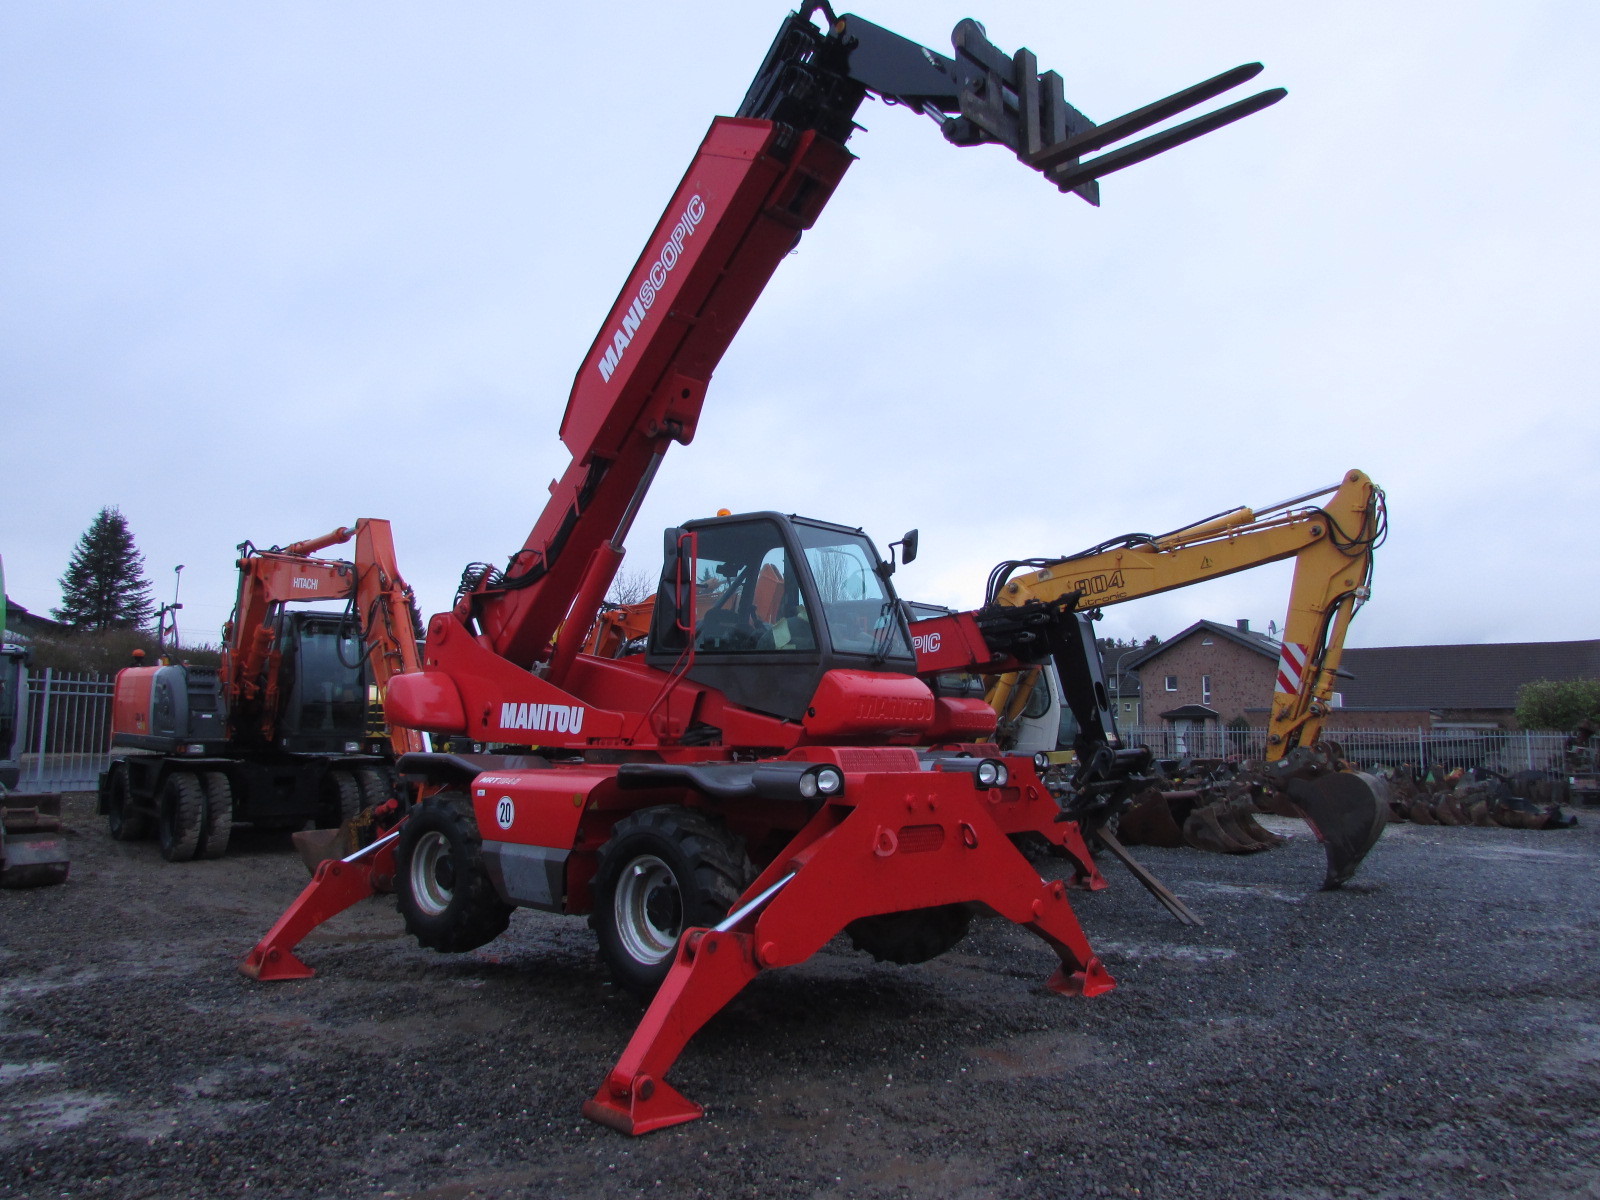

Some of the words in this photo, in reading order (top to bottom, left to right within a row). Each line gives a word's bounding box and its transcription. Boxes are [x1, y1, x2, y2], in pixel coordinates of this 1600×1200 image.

[598, 194, 705, 384] MANISCOPIC
[293, 577, 318, 590] HITACHI
[1074, 569, 1125, 597] 904
[1077, 591, 1127, 608] Litronic
[499, 702, 585, 735] MANITOU
[500, 802, 511, 823] 20
